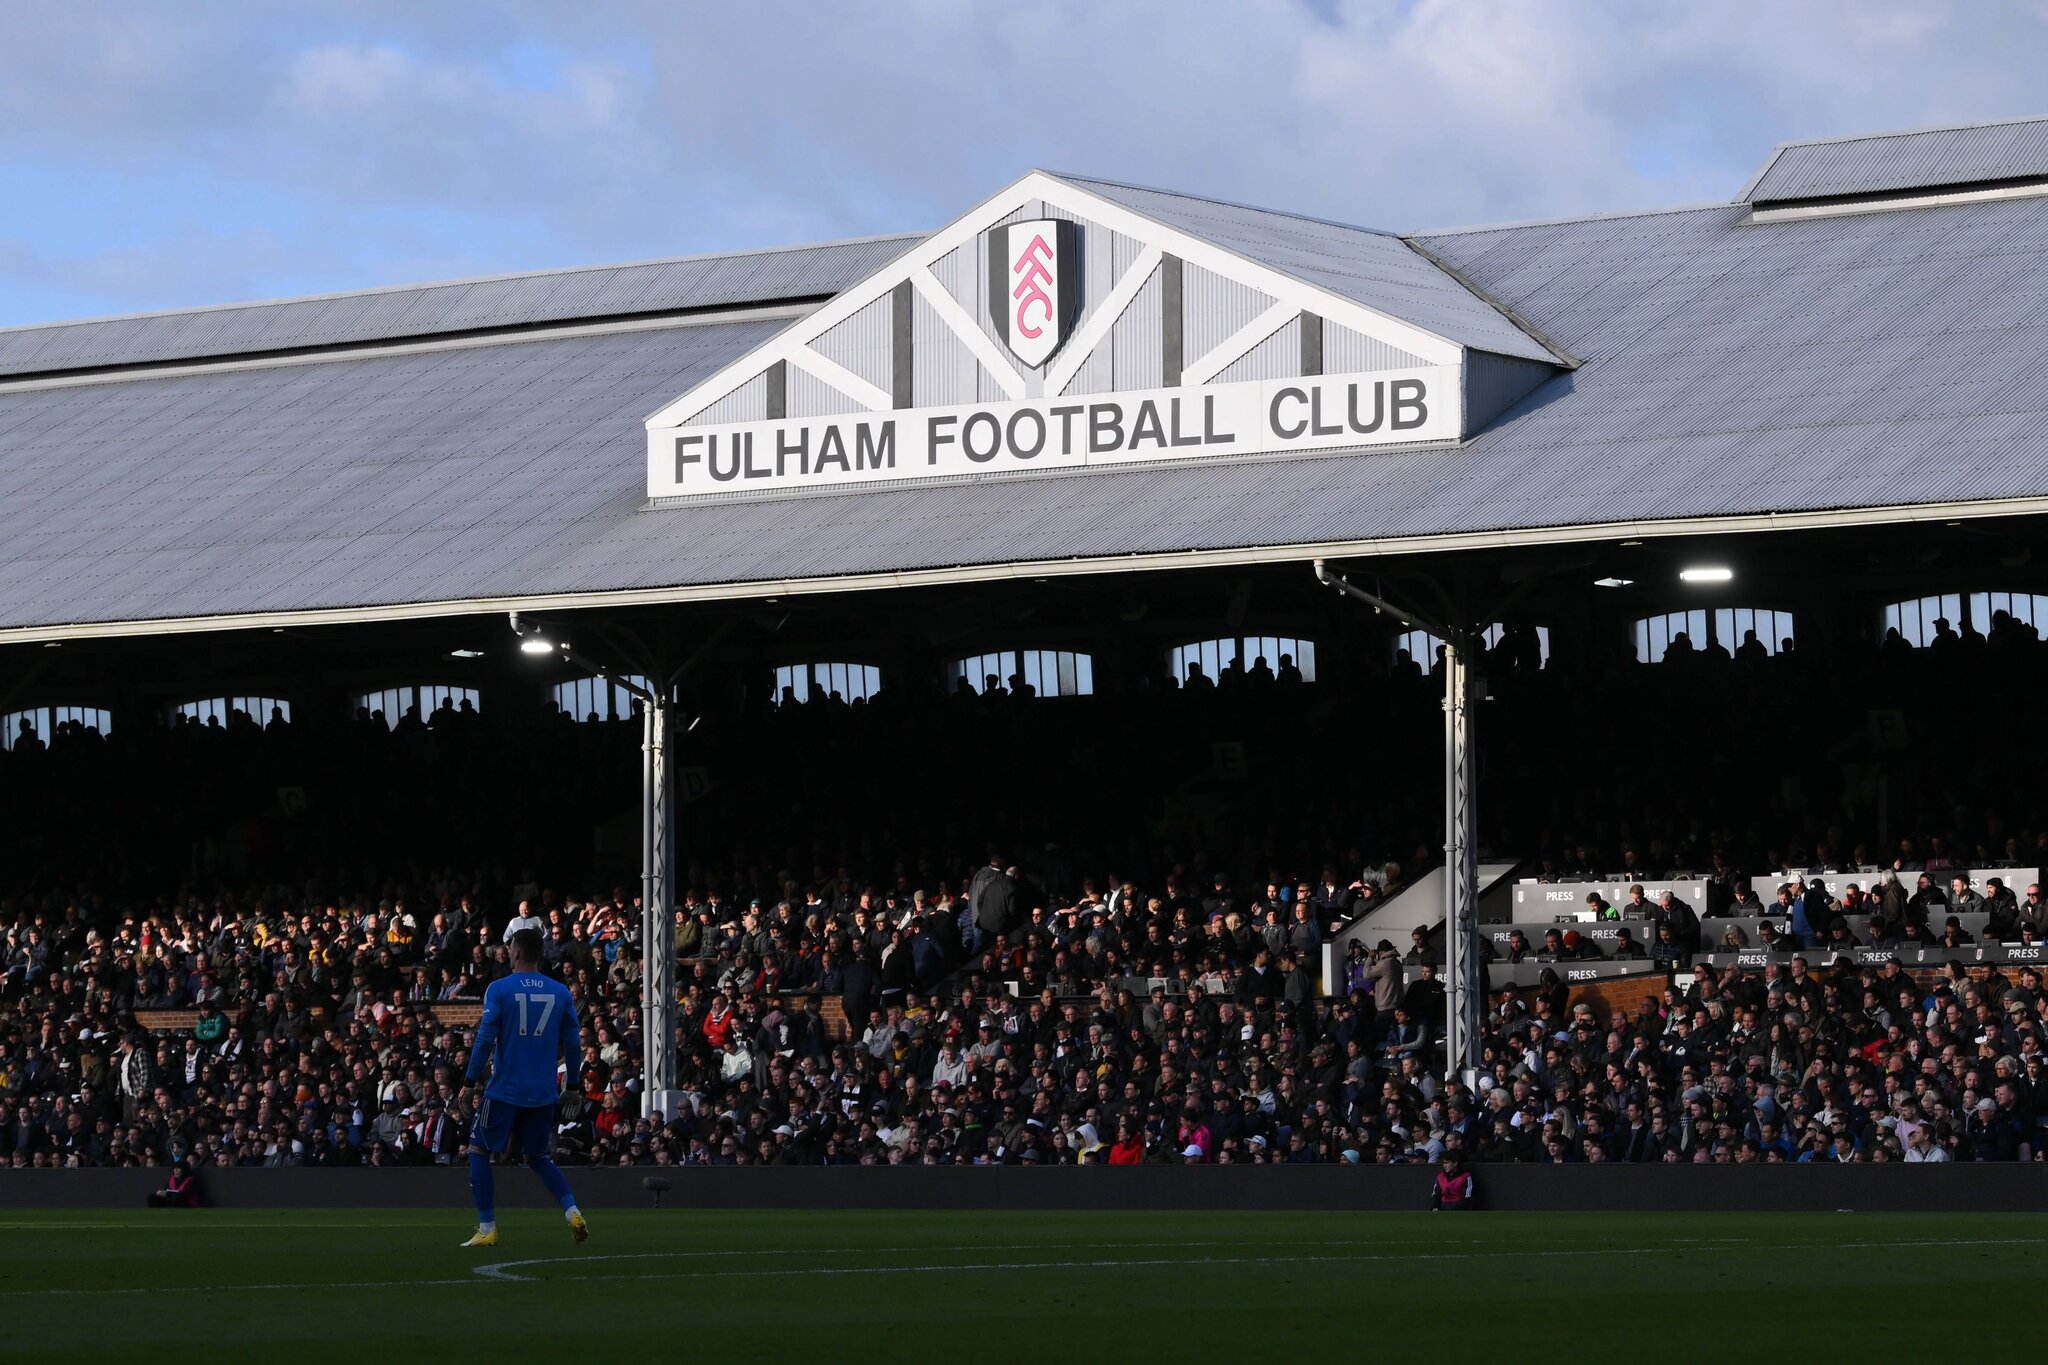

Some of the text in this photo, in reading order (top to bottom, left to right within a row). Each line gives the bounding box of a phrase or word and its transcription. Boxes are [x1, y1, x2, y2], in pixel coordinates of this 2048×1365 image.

[1013, 234, 1054, 339] FFC
[674, 378, 1429, 485] FULHAM FOOTBALL CLUB
[1546, 891, 1574, 902] PRESS
[2007, 948, 2039, 959] PRESS
[1737, 954, 1768, 965] PRESS
[1568, 970, 1597, 980] PRESS
[519, 978, 544, 989] LENO
[514, 993, 556, 1037] 17
